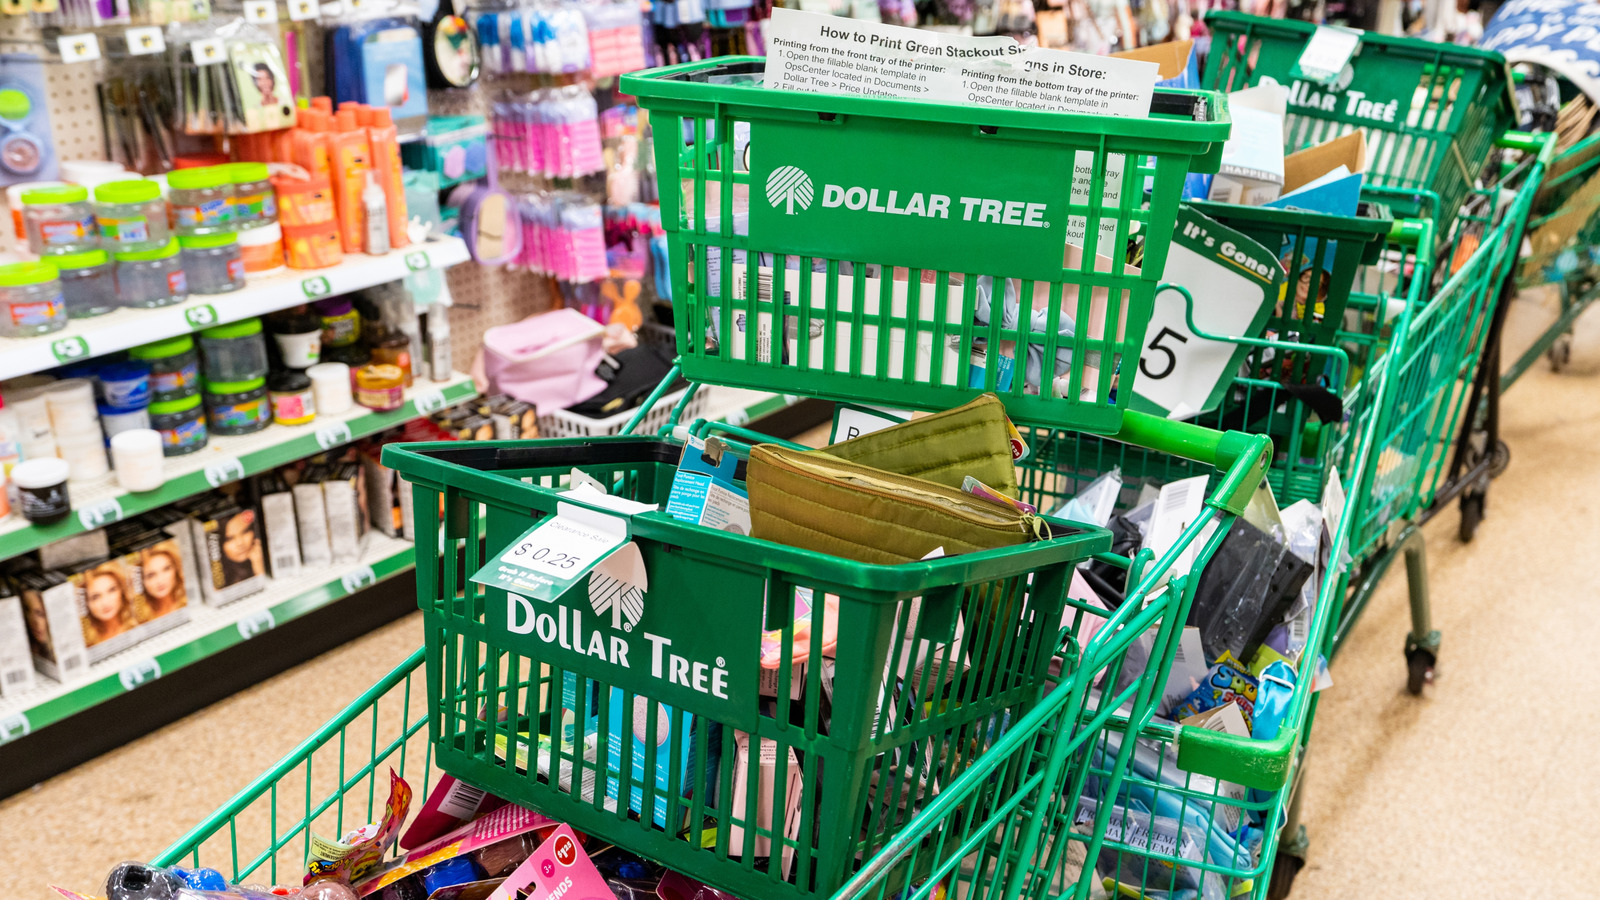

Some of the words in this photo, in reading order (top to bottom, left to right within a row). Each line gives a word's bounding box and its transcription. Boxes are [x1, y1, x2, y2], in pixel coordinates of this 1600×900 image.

[774, 38, 807, 51] Printing
[809, 44, 829, 54] from
[832, 47, 844, 56] the
[847, 50, 867, 60] front
[870, 54, 886, 65] tray
[888, 57, 898, 66] of
[899, 59, 912, 68] the
[914, 62, 946, 76] printer:
[779, 50, 785, 58] 1.
[786, 50, 809, 64] Open
[811, 55, 825, 64] the
[827, 58, 853, 69] fillable
[856, 62, 878, 74] blank
[880, 68, 917, 81] template
[918, 73, 926, 82] in
[820, 26, 850, 40] How
[853, 31, 866, 43] to
[870, 35, 902, 50] Print
[906, 40, 942, 56] Green
[946, 45, 1004, 58] Stackout
[1052, 62, 1064, 74] in
[1068, 64, 1106, 80] Store:
[783, 72, 807, 84] Dollar
[810, 77, 829, 88] Tree
[840, 84, 860, 94] Price
[785, 61, 829, 76] OpsCenter
[832, 69, 862, 82] located
[864, 74, 872, 84] in
[874, 77, 921, 93] Documents
[961, 68, 995, 82] Printing
[997, 74, 1017, 86] from
[1019, 78, 1032, 87] the
[1035, 80, 1064, 91] bottom
[1067, 84, 1082, 95] tray
[1085, 86, 1095, 96] of
[1095, 89, 1108, 97] the
[1110, 92, 1139, 102] printer:
[963, 81, 968, 89] 1.
[970, 82, 993, 94] Open
[995, 86, 1008, 95] the
[1011, 87, 1037, 99] fillable
[1040, 92, 1062, 102] blank
[1064, 96, 1099, 108] template
[1101, 100, 1108, 108] in
[968, 92, 1013, 107] OpsCenter
[1015, 100, 1045, 110] located
[1226, 164, 1276, 180] HAPPIER
[822, 184, 950, 218] DOLLAR
[960, 197, 1047, 228] TREE
[1183, 222, 1215, 248] It's
[1220, 242, 1275, 280] Gone!
[550, 521, 589, 538] Clearance
[514, 542, 532, 556] $
[532, 547, 580, 569] 0.25
[498, 566, 517, 576] Grab
[519, 570, 527, 578] It
[528, 572, 554, 586] Before
[499, 574, 512, 582] It's
[513, 578, 540, 589] Gone!
[644, 632, 728, 700] TREE
[1082, 808, 1130, 830] FRMAN
[1132, 837, 1186, 858] FREMAN
[544, 864, 552, 874] 3+
